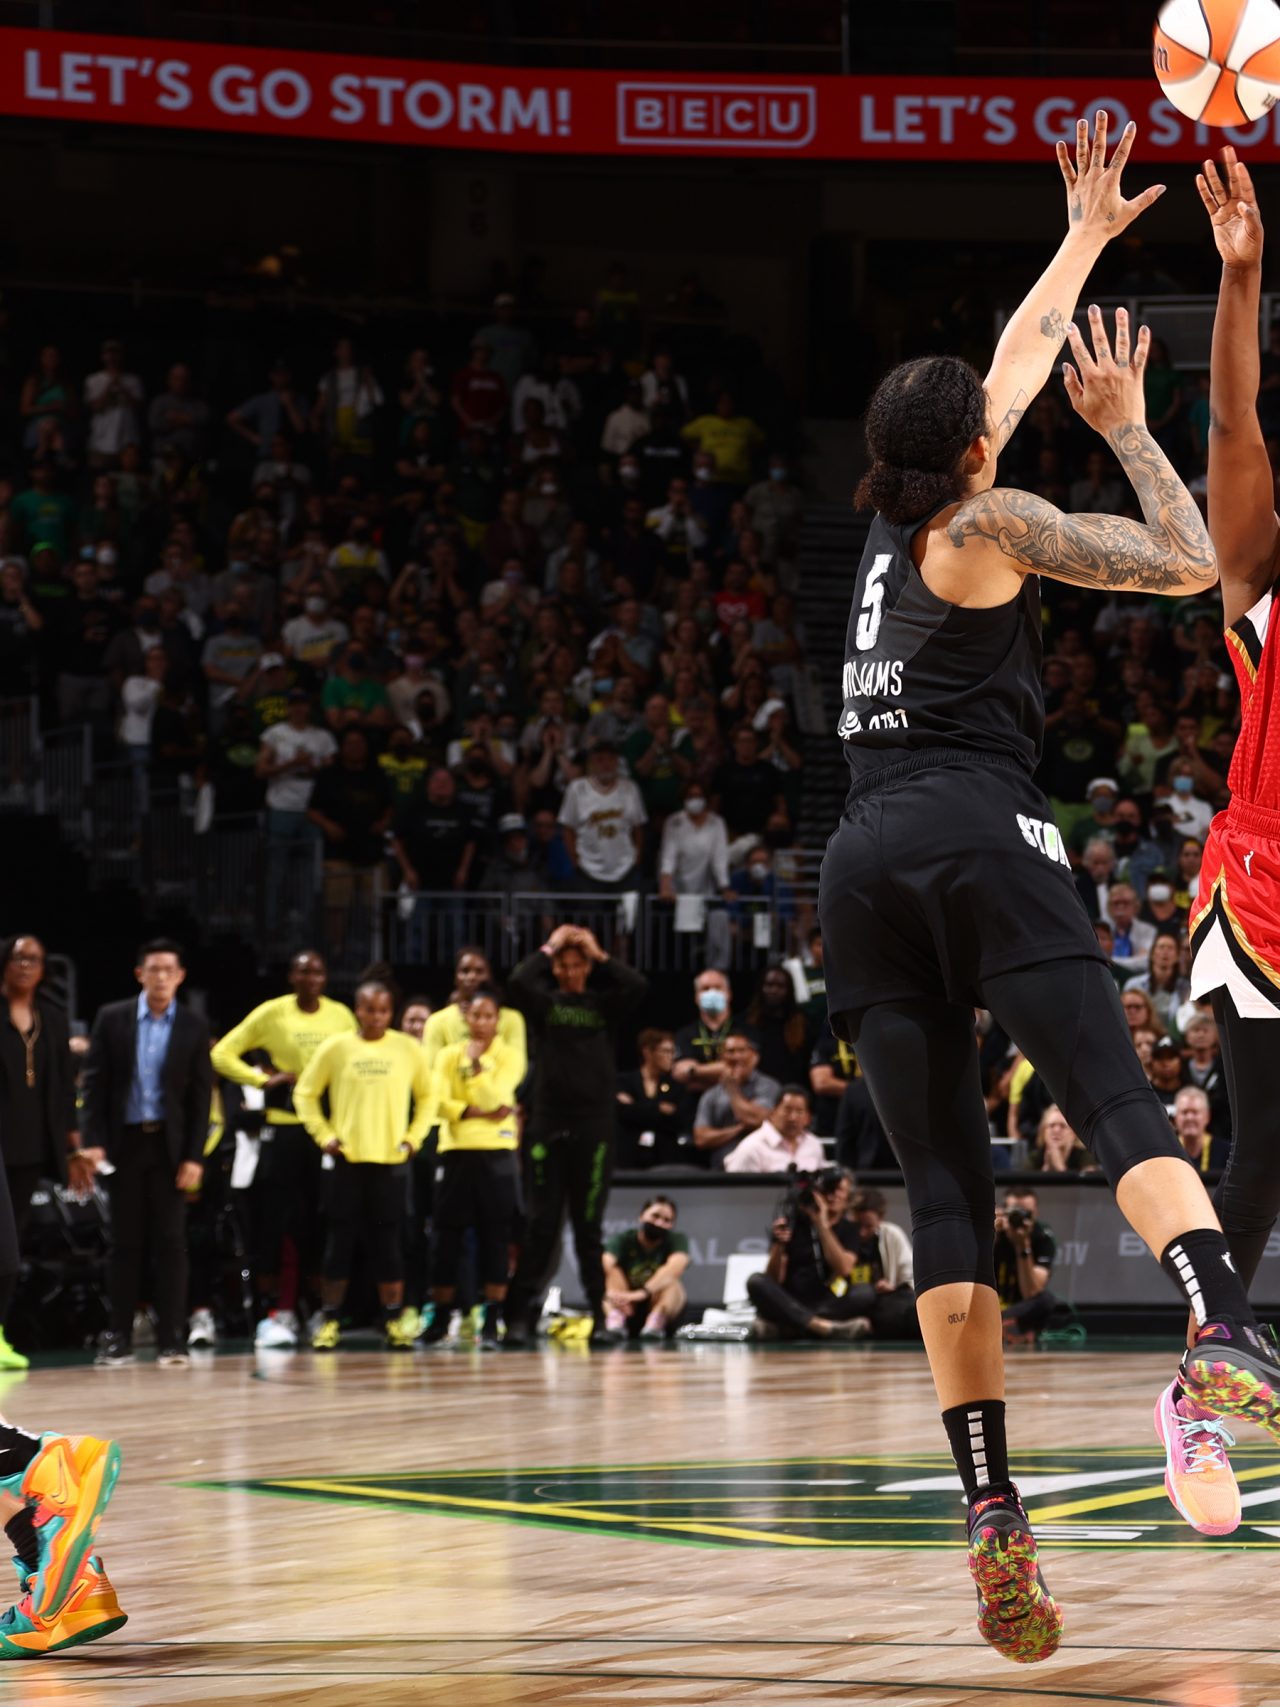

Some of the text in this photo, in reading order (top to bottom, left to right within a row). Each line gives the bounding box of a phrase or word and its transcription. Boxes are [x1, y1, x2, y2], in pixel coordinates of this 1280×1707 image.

[23, 48, 573, 137] LET'S GO STORM!
[859, 95, 1018, 146] LET'S
[1032, 97, 1130, 146] GO
[855, 553, 894, 651] 5
